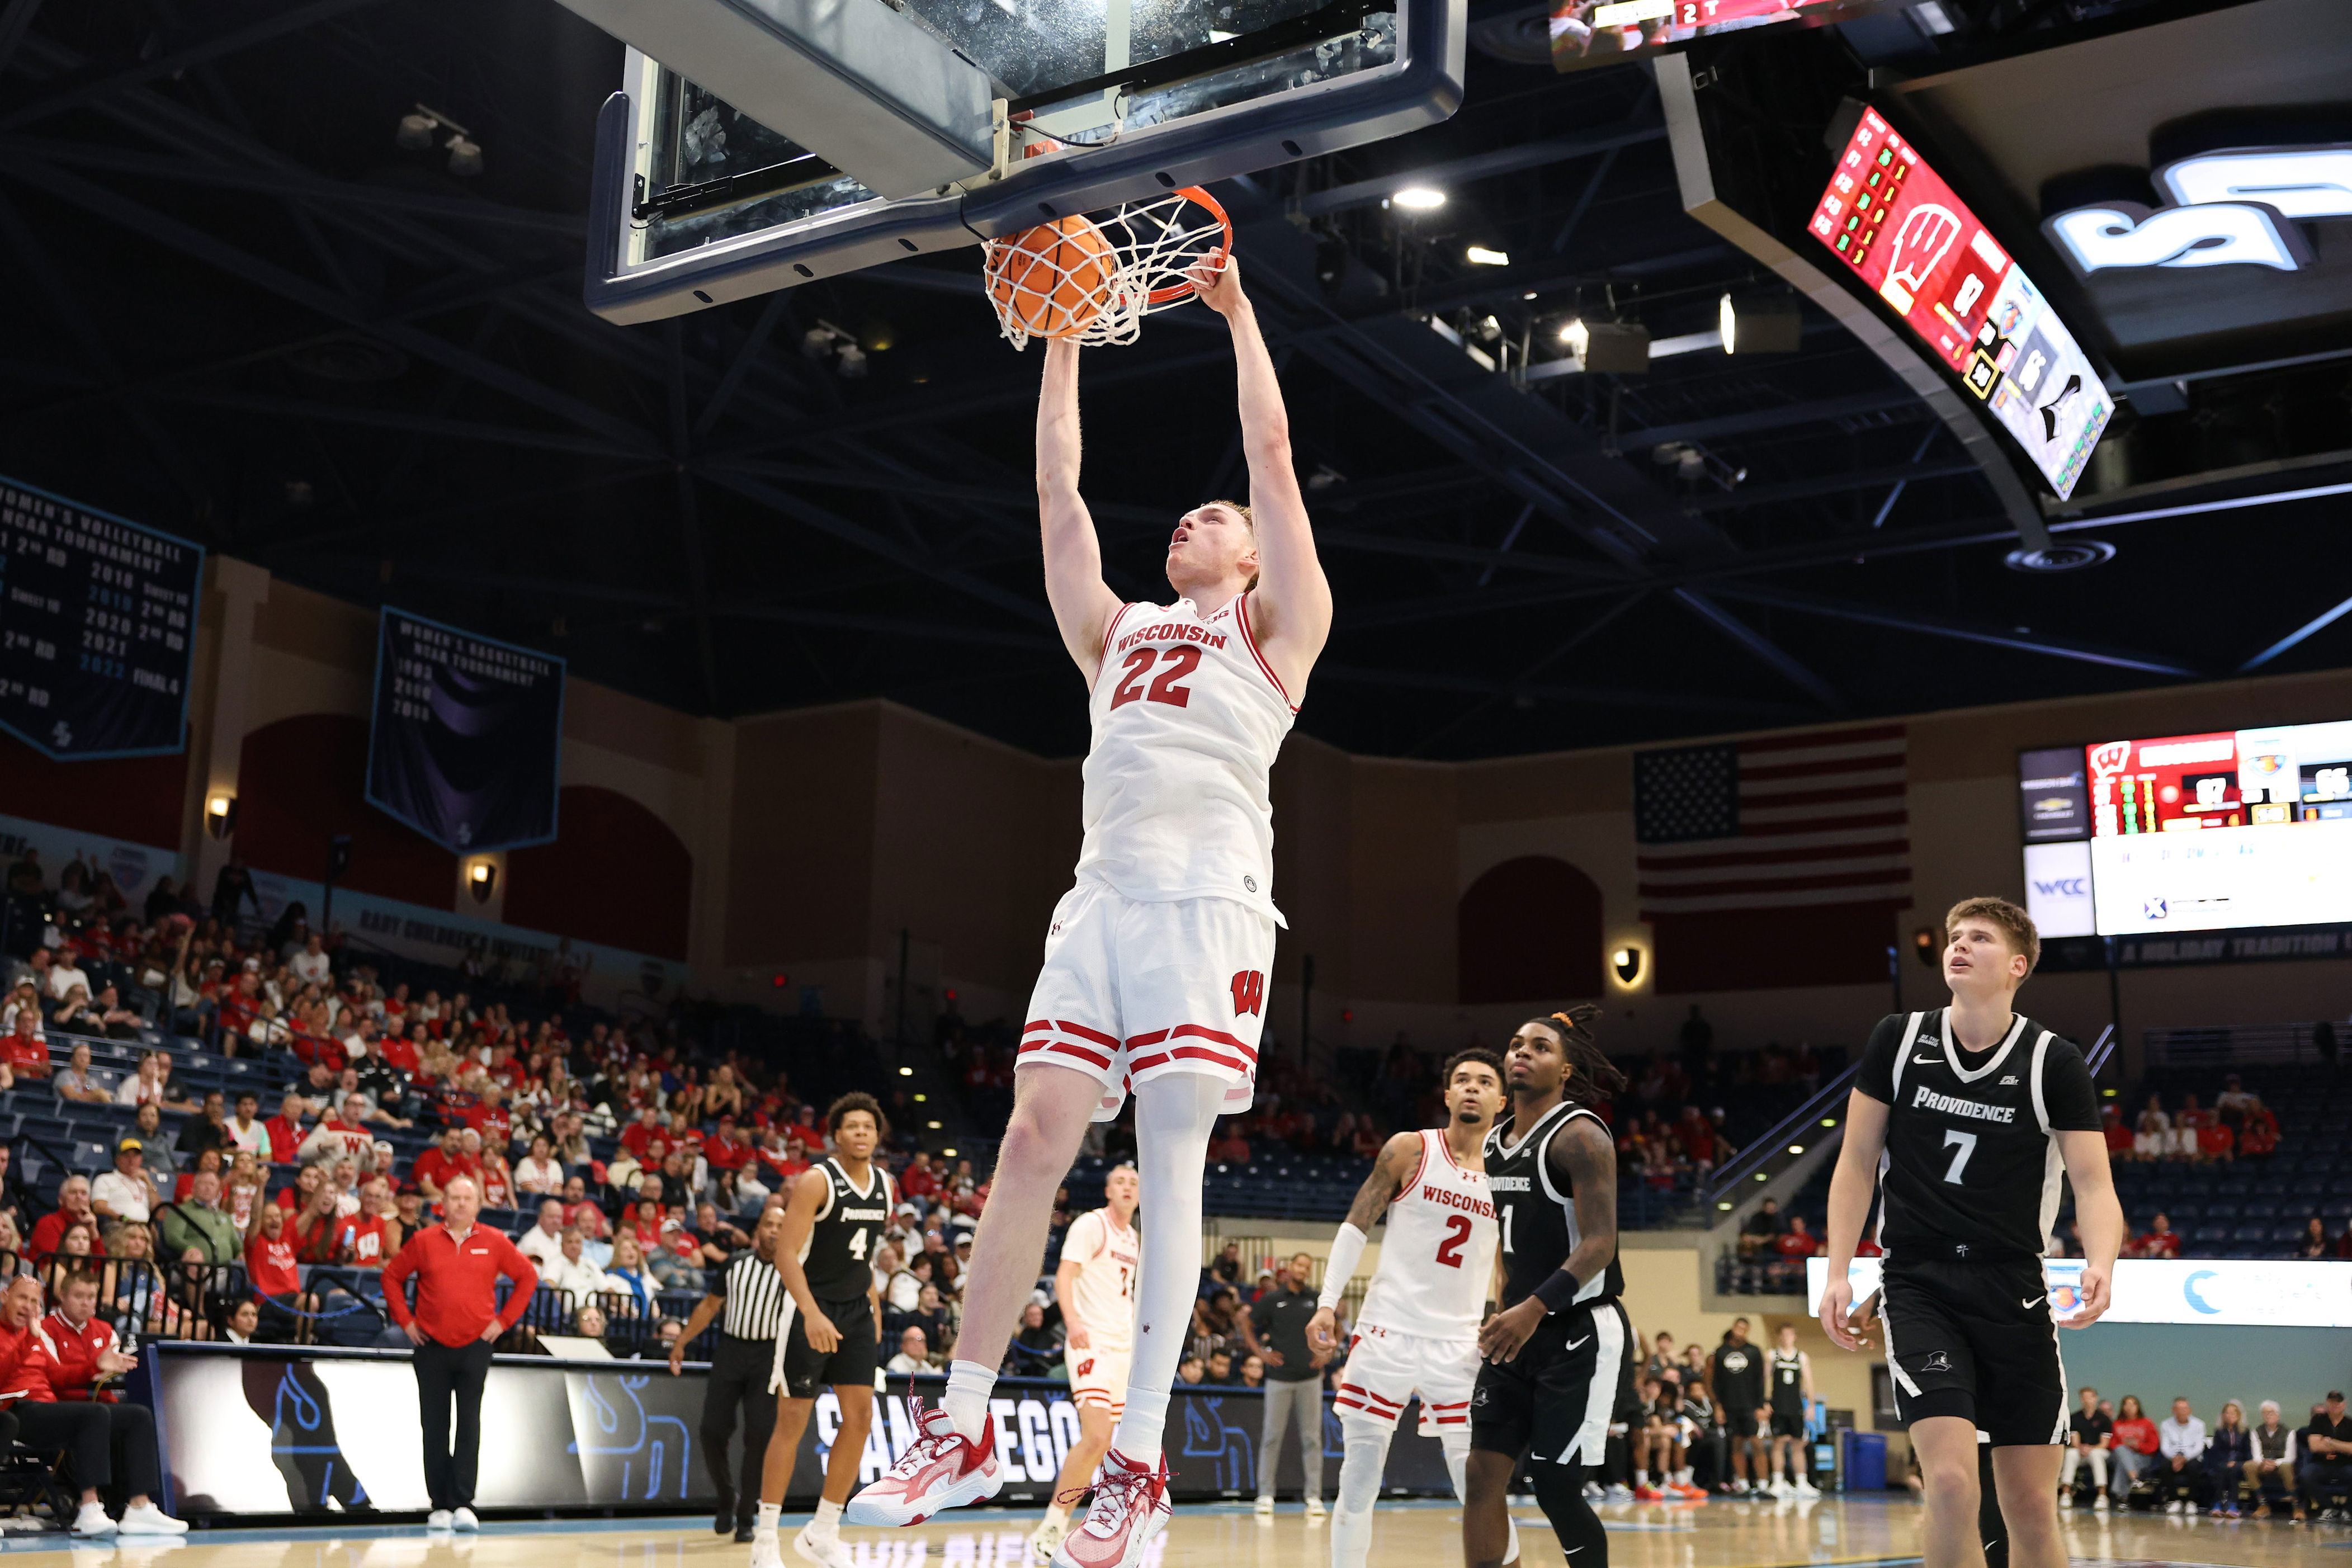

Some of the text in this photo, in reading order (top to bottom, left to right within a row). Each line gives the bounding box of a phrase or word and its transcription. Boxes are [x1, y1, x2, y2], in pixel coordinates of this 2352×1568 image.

[0, 485, 181, 564] OMEN'S VOLLEYBALL
[2, 507, 162, 574] NCAA TOURNAMENT
[82, 630, 127, 657] 2021
[1116, 624, 1227, 655] WISCONSIN
[80, 653, 125, 680] 2022
[1110, 644, 1202, 711] 22
[2033, 877, 2087, 896] WCC
[2231, 932, 2338, 958] TRADITION
[1230, 970, 1264, 1018] W
[1910, 1085, 2016, 1124] PROVIDENCE
[343, 1136, 362, 1154] W
[1942, 1128, 1977, 1185] 7
[848, 1227, 868, 1260] 4
[1435, 1215, 1472, 1269] 2
[1501, 1204, 1515, 1253] 1
[1109, 1446, 1128, 1467] WISCONSIN
